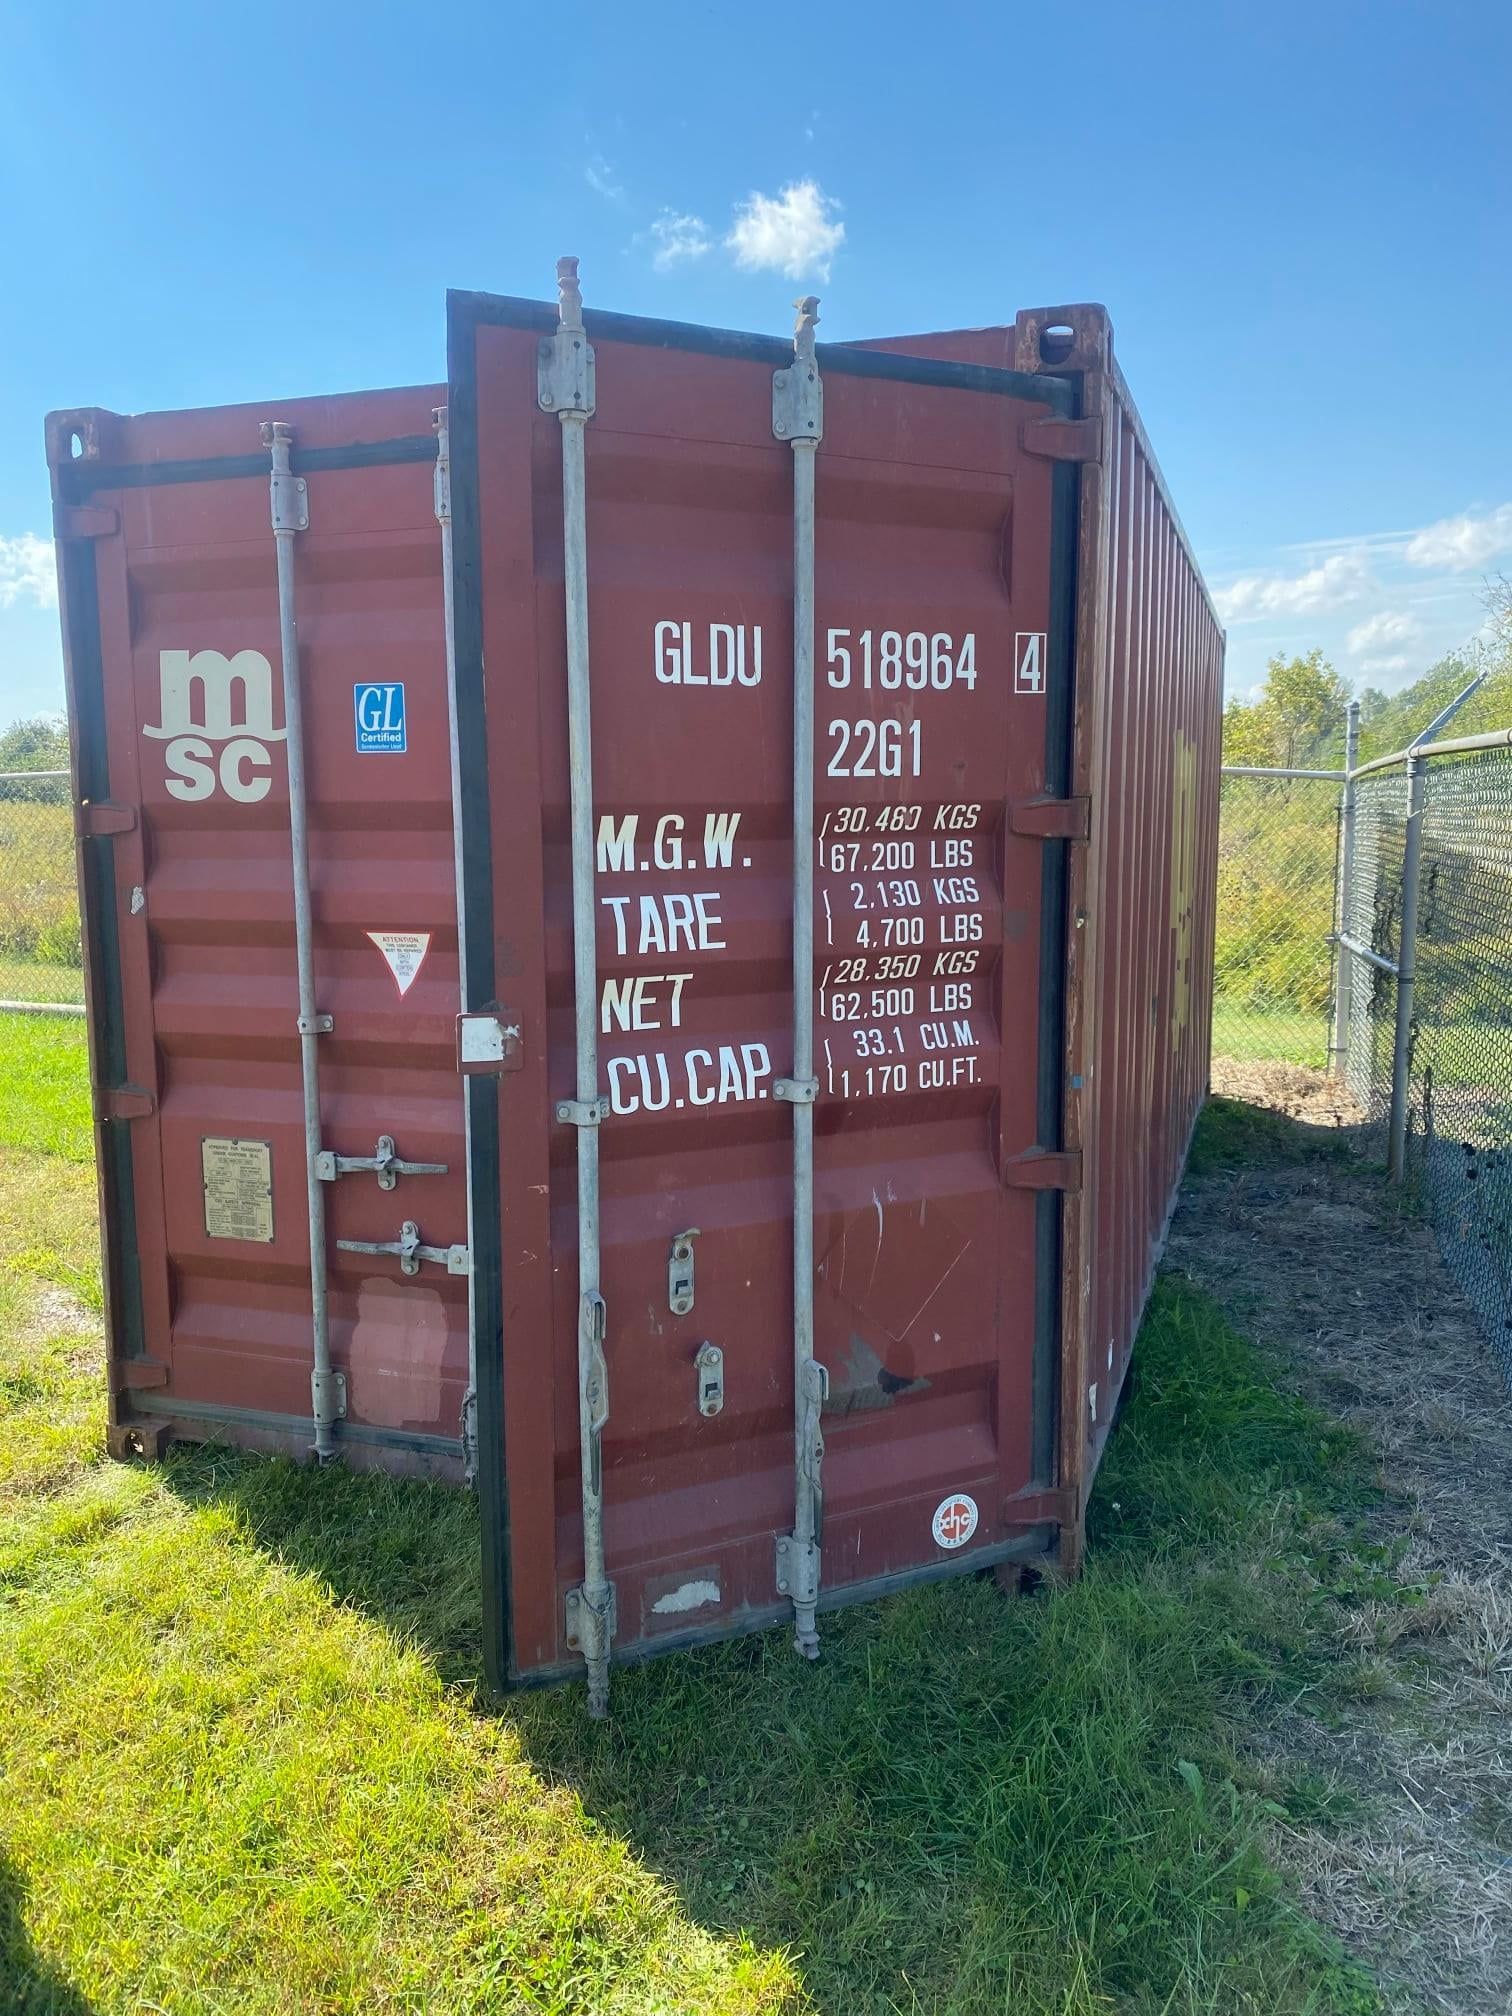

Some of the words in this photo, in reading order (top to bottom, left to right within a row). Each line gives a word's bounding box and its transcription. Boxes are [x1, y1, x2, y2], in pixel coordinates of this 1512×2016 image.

[655, 621, 762, 686] GLDU
[827, 628, 977, 690] 518964
[1020, 636, 1041, 690] 4
[358, 687, 402, 731] GL
[361, 732, 402, 742] Certified
[827, 719, 921, 777] 22G1
[597, 813, 752, 873] M.G.W.
[933, 804, 981, 830] KGS
[831, 841, 915, 873] 67,200
[930, 839, 973, 869] LBS
[602, 893, 726, 955] TARE
[850, 879, 922, 910] 2,130
[933, 877, 980, 905] KGS
[856, 917, 924, 948] 4,700
[940, 913, 983, 943] LBS
[601, 973, 694, 1033] NET
[833, 954, 922, 984] 28,350
[932, 950, 980, 976] KGS
[831, 988, 914, 1022] 62,500
[930, 983, 972, 1013] LBS
[607, 1043, 772, 1114] CU.CAP.
[852, 1026, 905, 1057] 33.1
[919, 1019, 980, 1050] CU.M.
[841, 1064, 907, 1098] 1,170
[918, 1056, 982, 1089] CU.FT.
